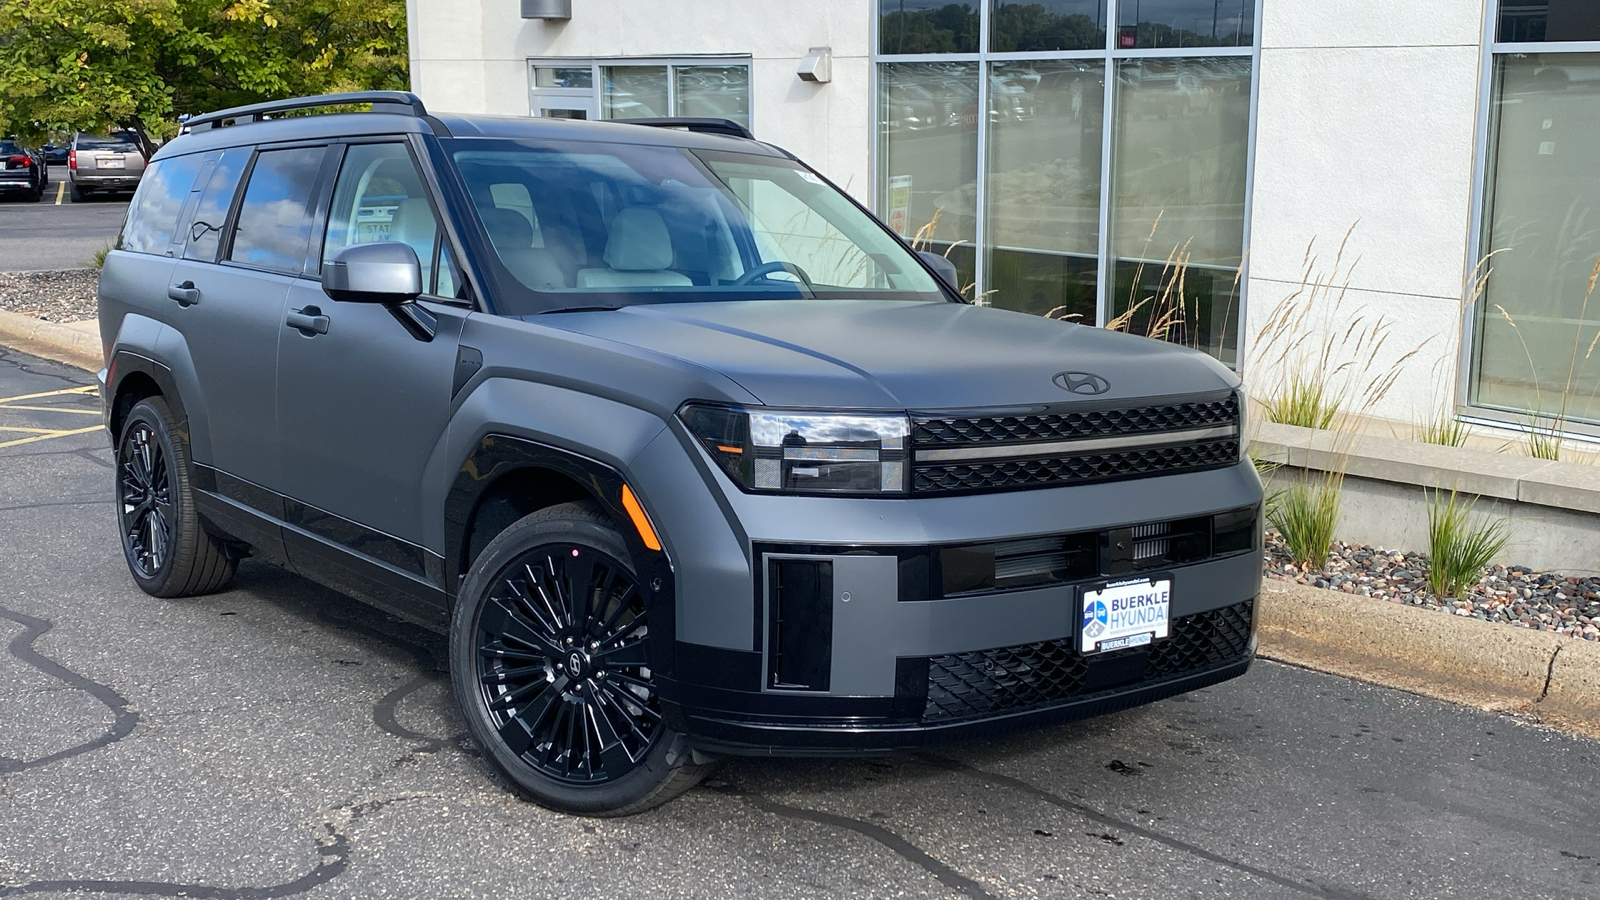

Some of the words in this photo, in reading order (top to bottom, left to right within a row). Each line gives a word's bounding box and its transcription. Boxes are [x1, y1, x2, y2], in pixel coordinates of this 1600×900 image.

[367, 225, 390, 233] STAT
[1111, 591, 1168, 611] BUERKLE
[1110, 604, 1168, 629] HYUNDAI
